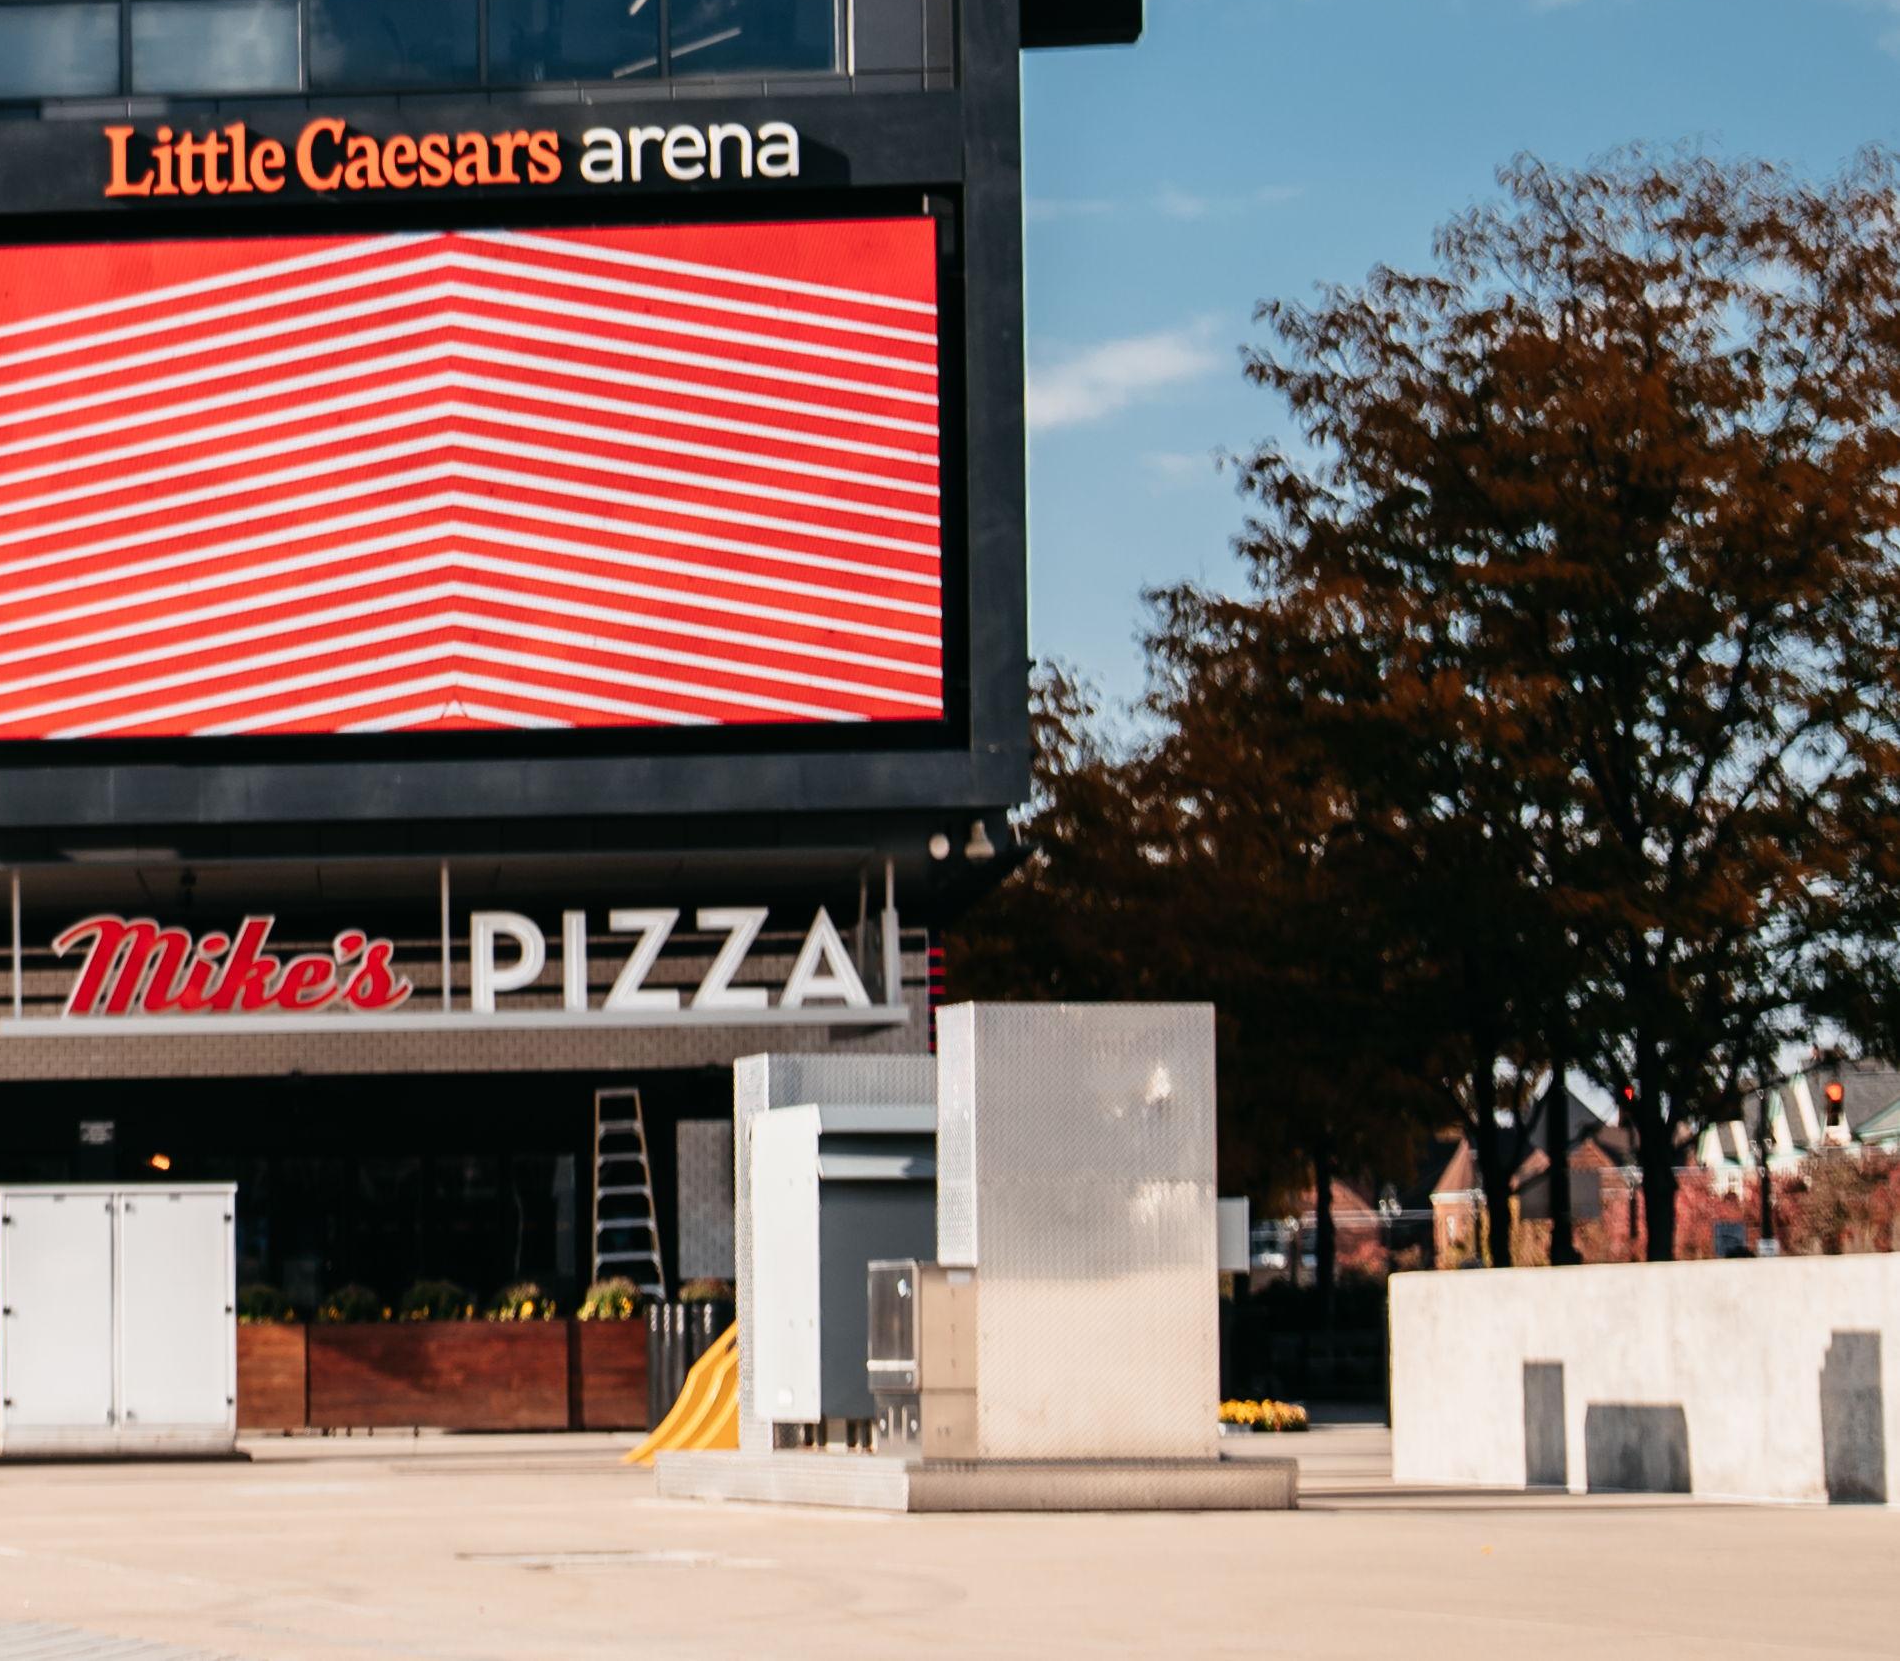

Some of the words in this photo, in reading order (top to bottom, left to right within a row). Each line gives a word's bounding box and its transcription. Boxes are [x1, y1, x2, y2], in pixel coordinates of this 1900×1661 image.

[103, 122, 287, 197] Little
[295, 117, 563, 191] Caesars
[578, 121, 801, 183] arena
[52, 914, 414, 1019] Mike's
[470, 905, 873, 1011] PIZZA
